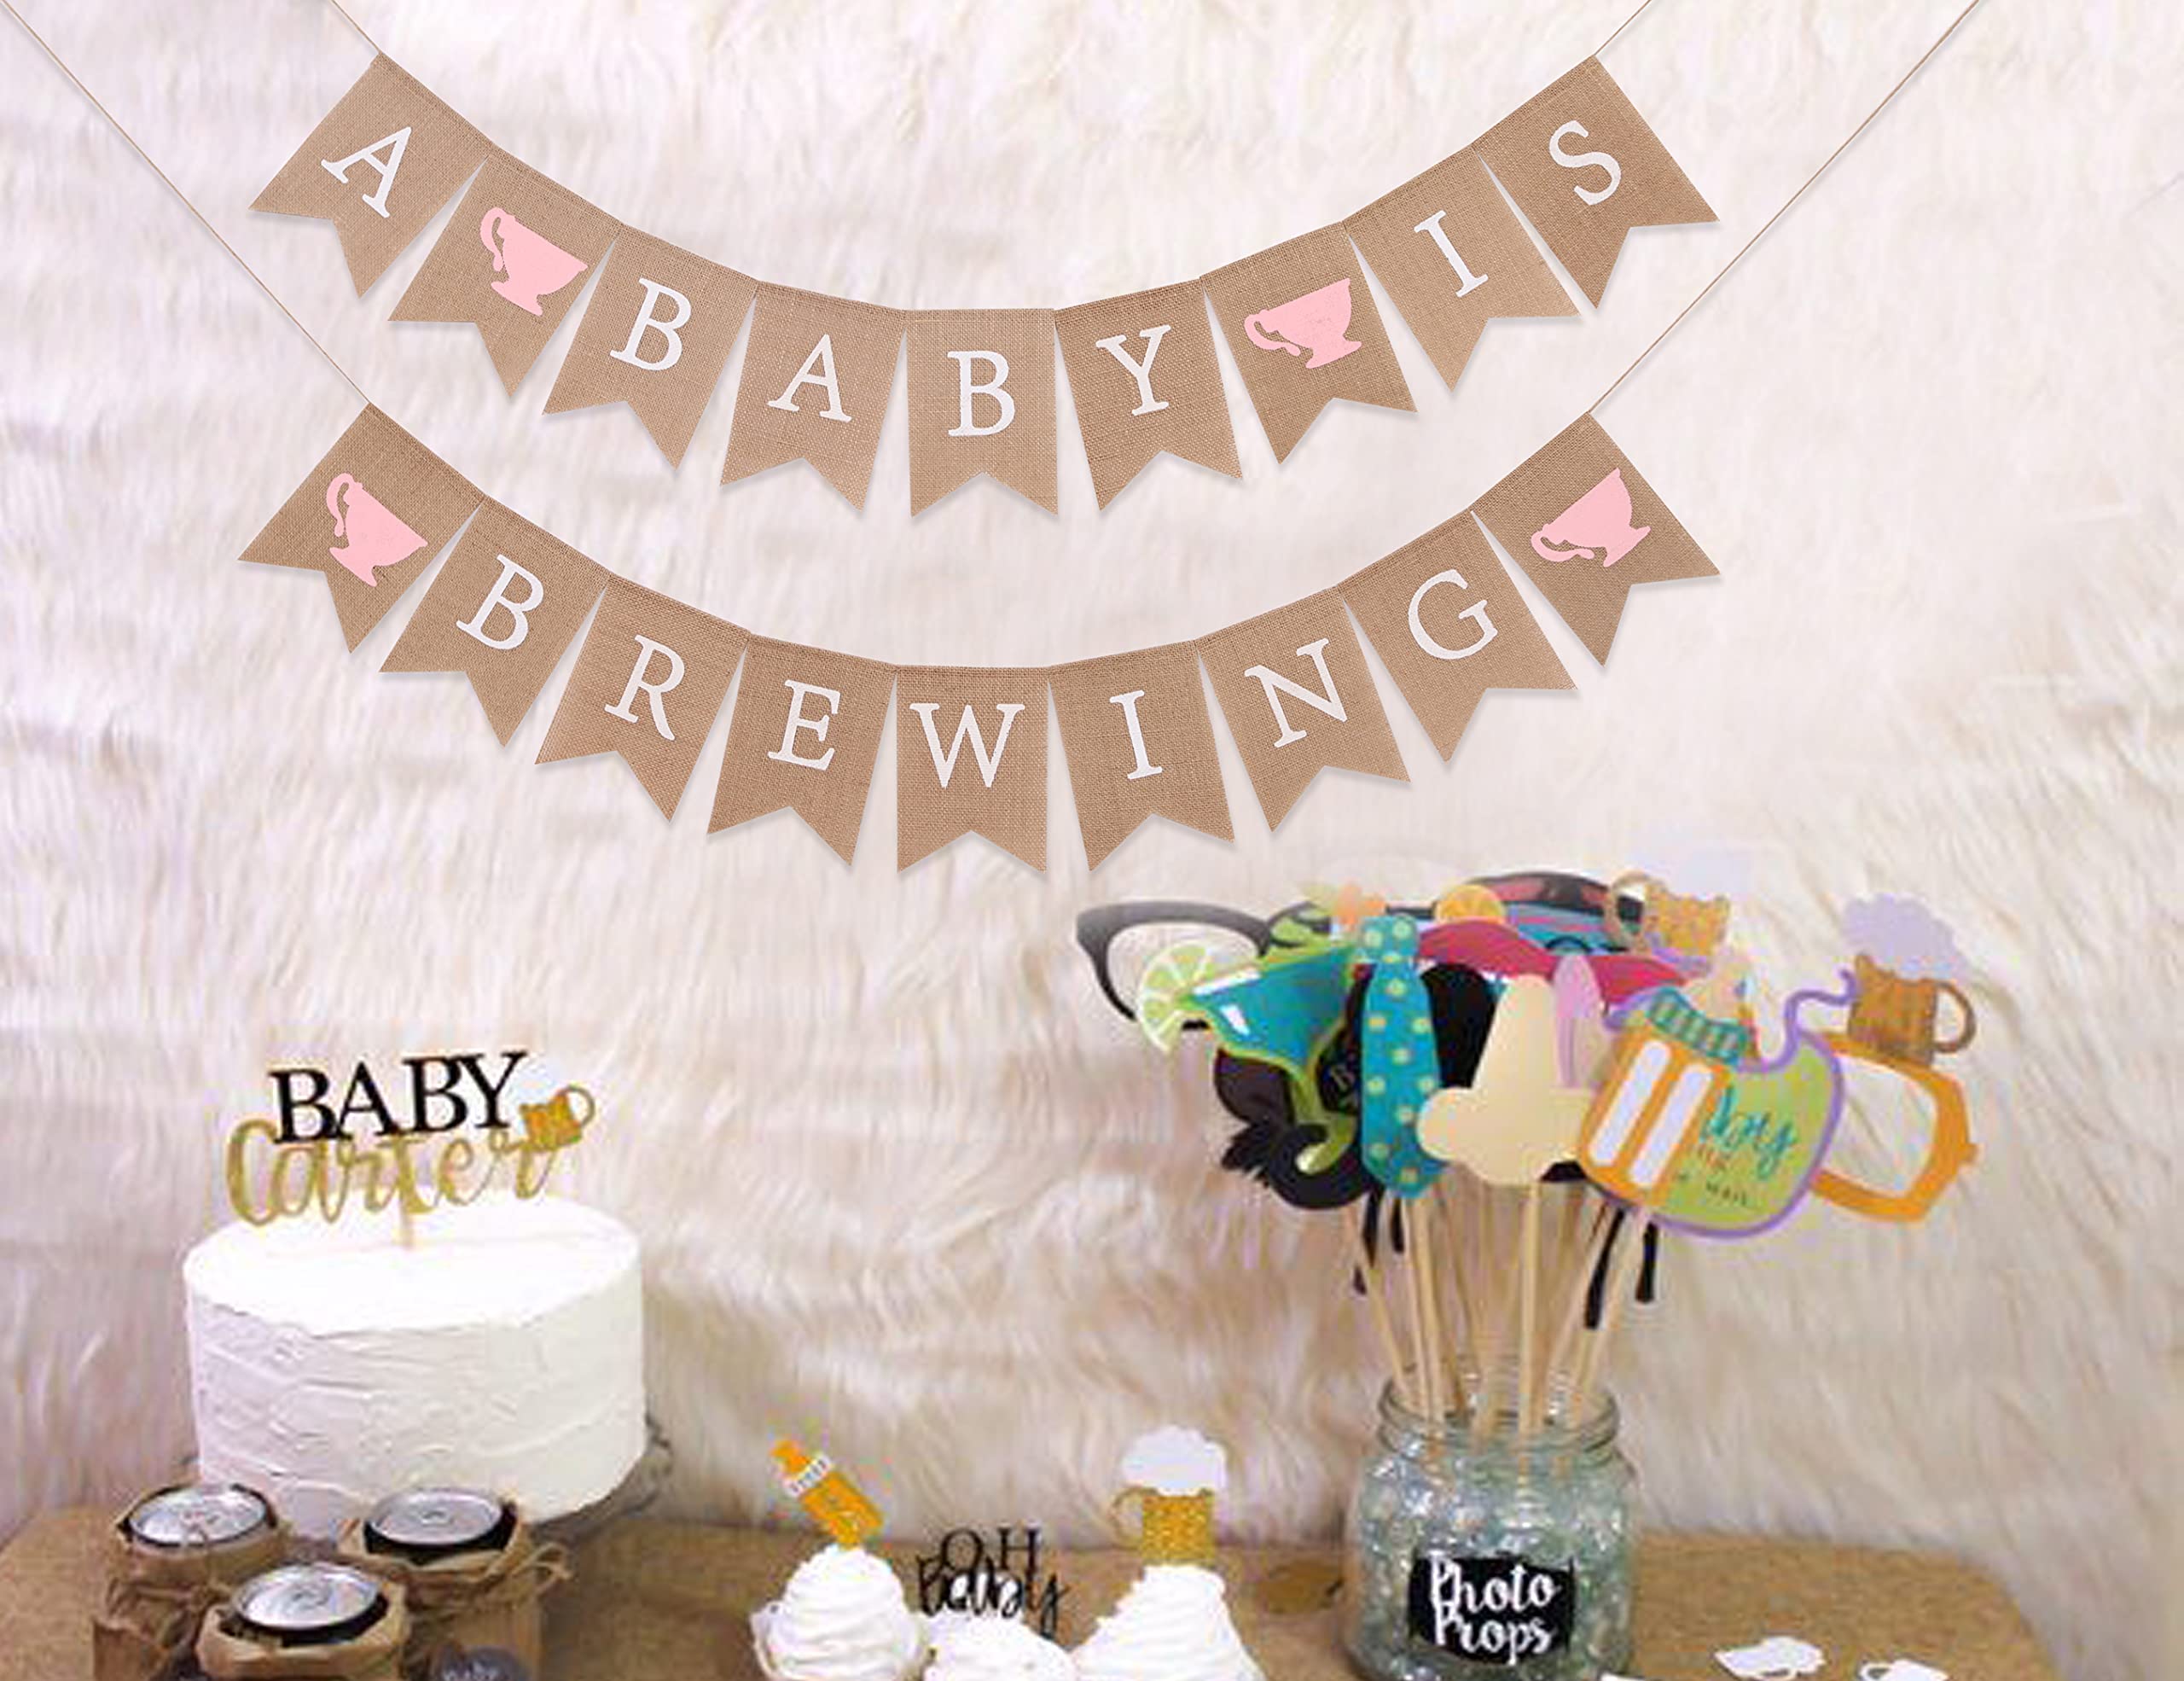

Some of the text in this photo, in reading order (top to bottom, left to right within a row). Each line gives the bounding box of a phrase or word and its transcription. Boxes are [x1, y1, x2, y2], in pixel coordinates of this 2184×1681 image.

[322, 120, 1622, 437] A BABY IS
[456, 555, 1497, 788] BREWING
[268, 1051, 527, 1143] BABY
[227, 1120, 556, 1226] Carter
[941, 1523, 1040, 1575] OH
[1429, 1549, 1562, 1614] Photo
[1433, 1599, 1558, 1666] Props
